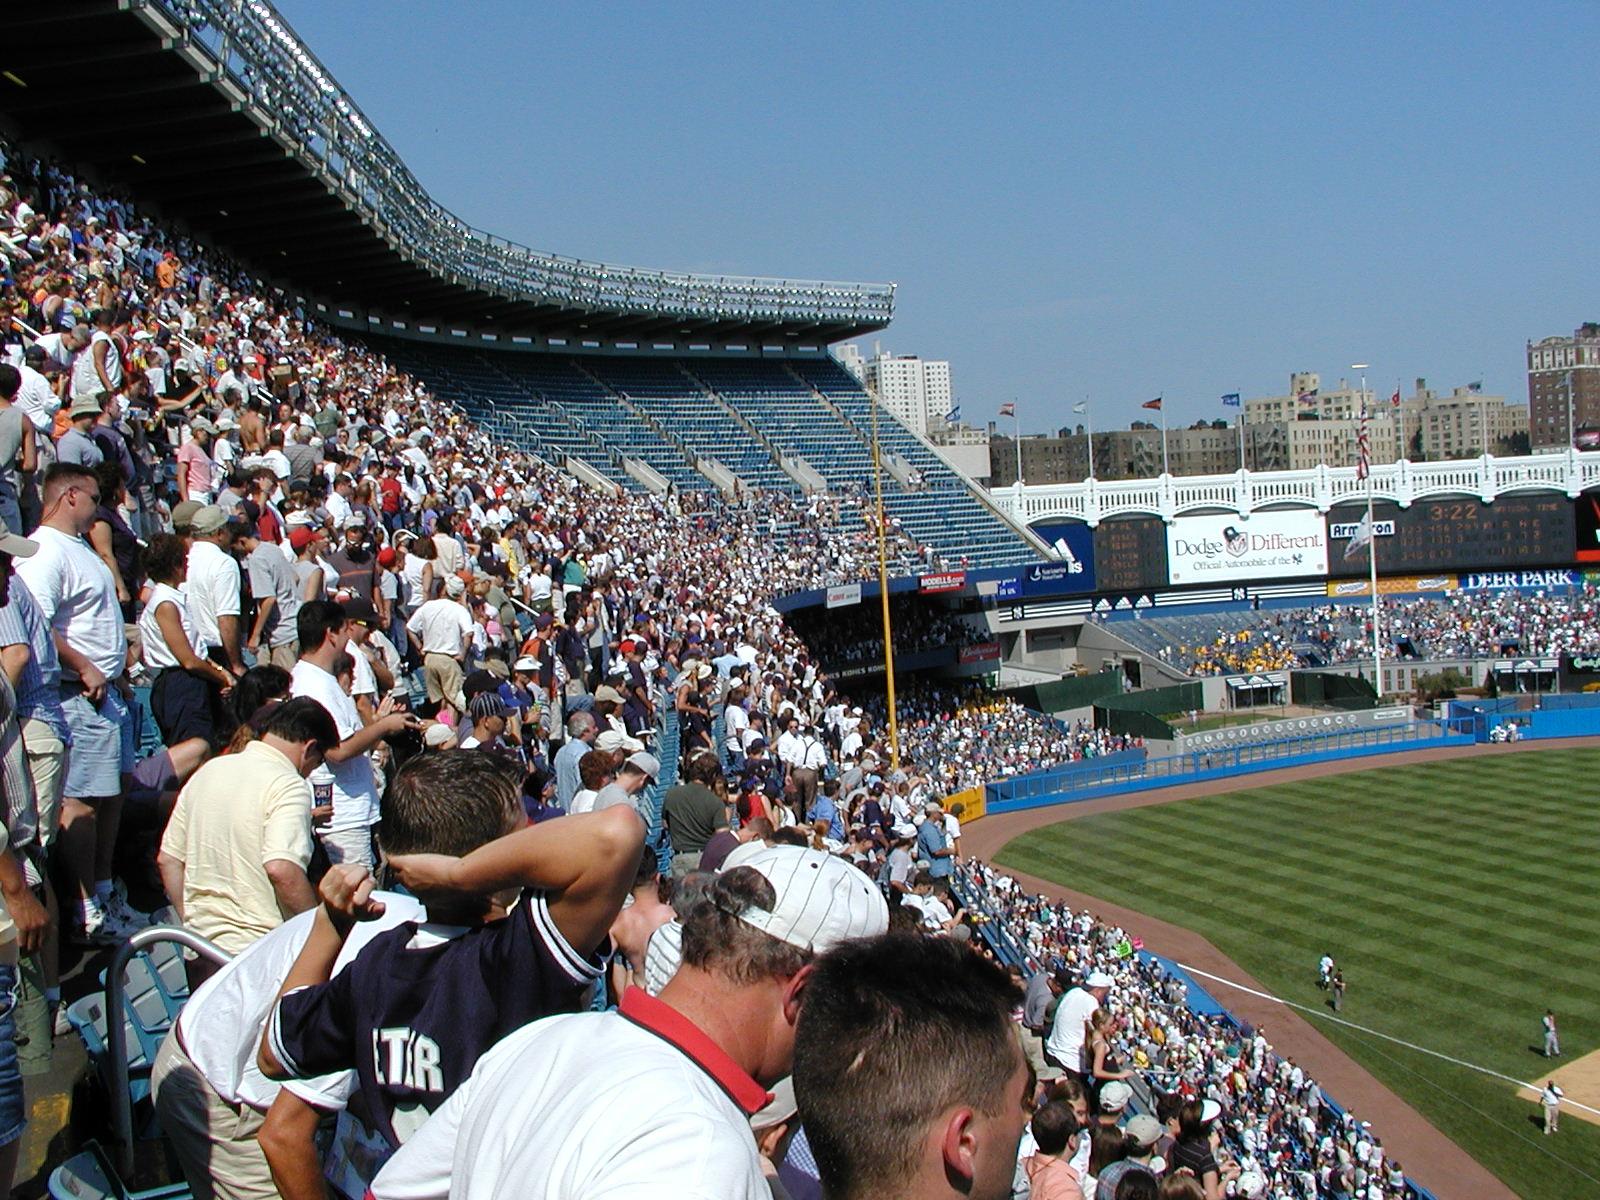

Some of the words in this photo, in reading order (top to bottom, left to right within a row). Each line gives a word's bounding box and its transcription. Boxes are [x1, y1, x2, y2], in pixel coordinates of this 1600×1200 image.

[1334, 523, 1392, 537] Armon
[1175, 538, 1223, 558] Dodge
[1252, 533, 1323, 551] Different.
[1193, 559, 1221, 570] Official
[1225, 556, 1267, 569] Automobile
[1269, 556, 1278, 566] of
[1468, 572, 1518, 589] DEER
[1521, 569, 1573, 586] PARK
